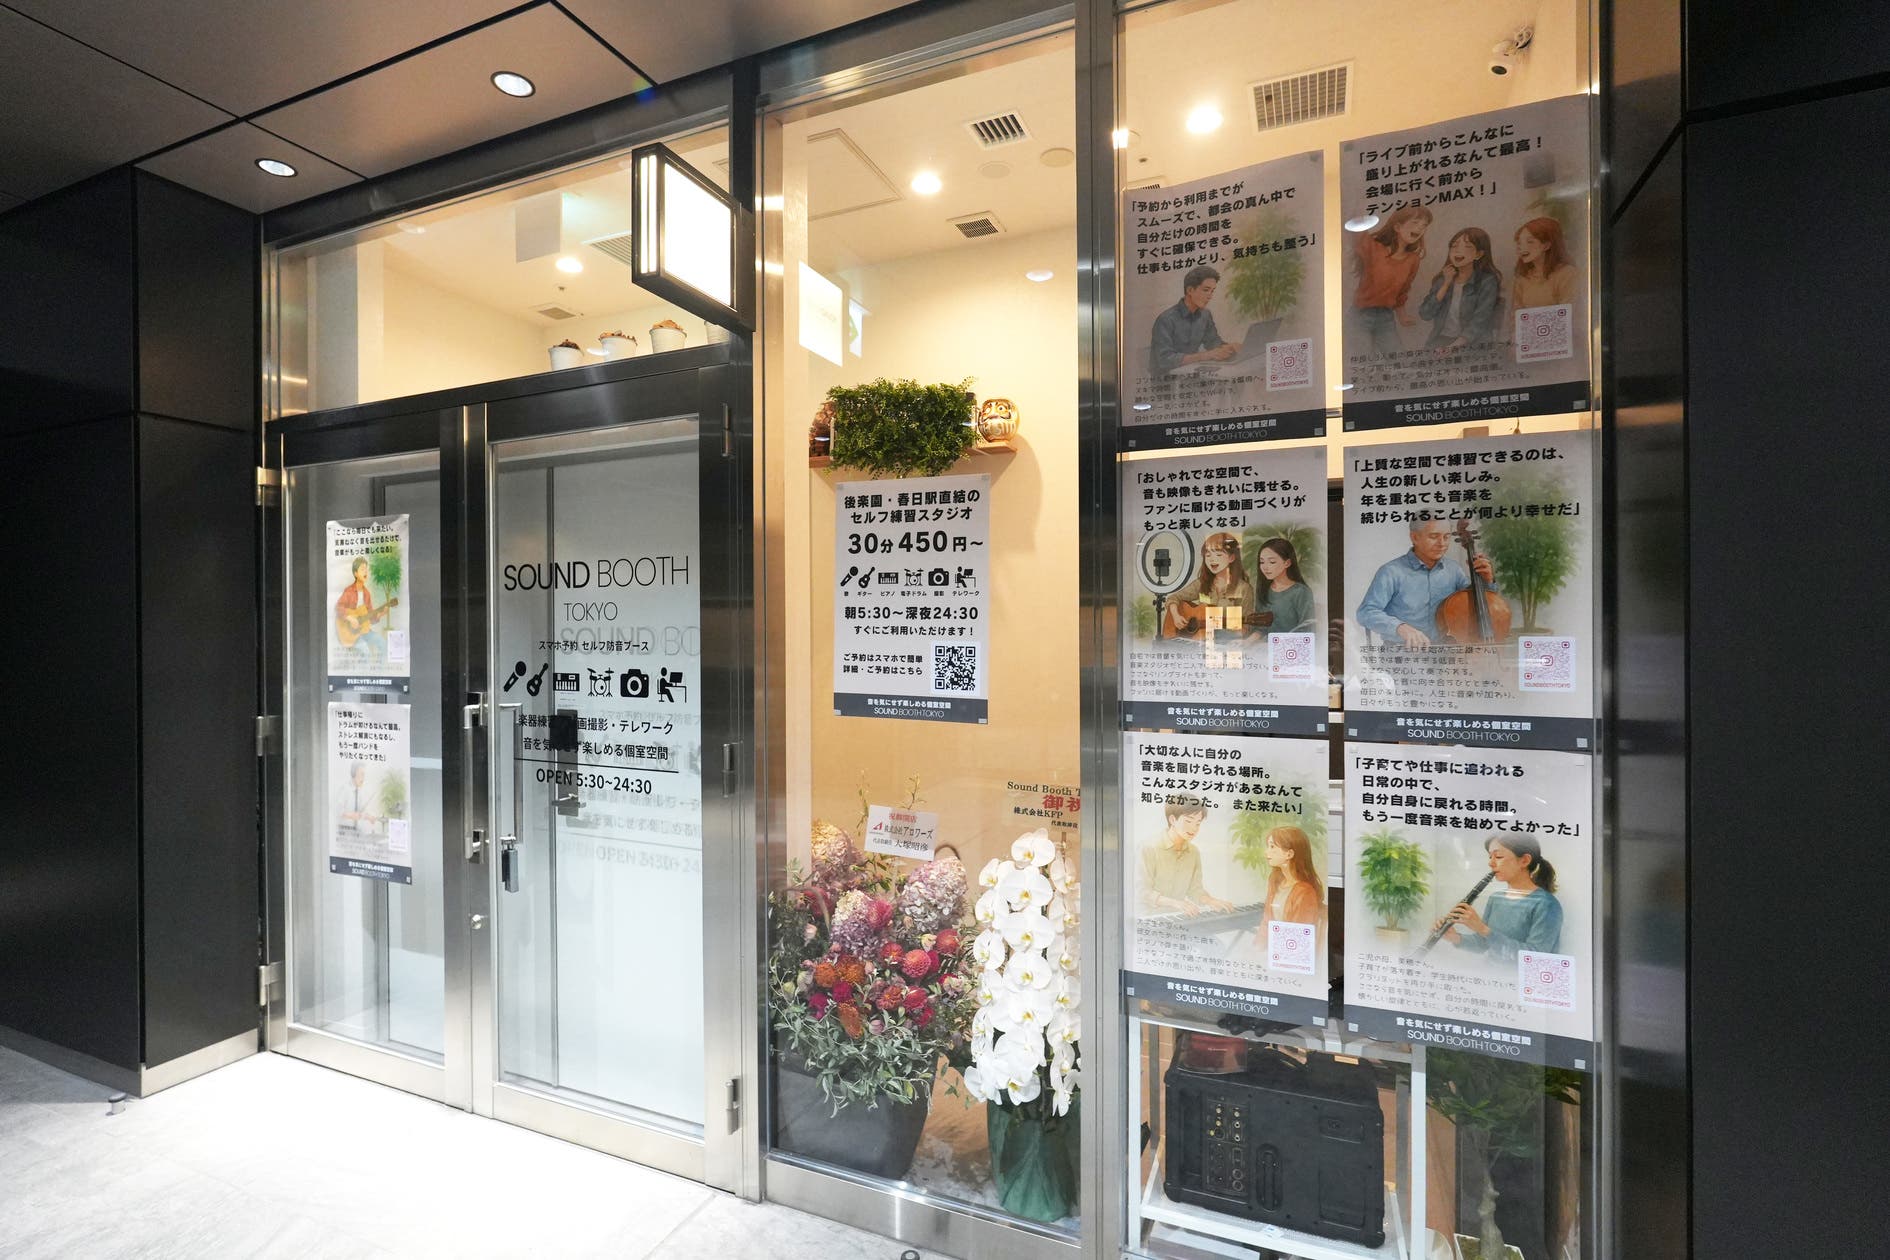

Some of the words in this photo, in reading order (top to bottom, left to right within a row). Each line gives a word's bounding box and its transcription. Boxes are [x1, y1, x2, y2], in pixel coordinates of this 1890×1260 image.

[1359, 124, 1514, 165] 「ライブ前からこんなに
[1366, 136, 1542, 182] 盛り上がれるなんて最高！
[1366, 167, 1482, 199] 会場に行く前から
[1131, 181, 1244, 213] 「予約から利用までが
[1366, 181, 1496, 216] テンションMAX！」
[1137, 188, 1296, 228] スムーズで、都会の真ん中で
[1137, 219, 1232, 244] 自分だけの時間を
[1137, 237, 1239, 259] すぐに確保できる。
[1137, 233, 1316, 274] 仕事もはかどり、気持ちも整う」
[1395, 393, 1530, 413] 音を気にせず楽しめる個室空間
[1406, 411, 1444, 423] SOUND
[1174, 435, 1206, 445] SOUND
[1354, 447, 1565, 473] 「上質な空間で練習できるのは、
[1137, 465, 1260, 485] 「おしゃれでな空間で、
[1361, 470, 1501, 489] 人生の新しい楽しみ。
[844, 489, 980, 509] 後楽園・春日駅直結の
[1143, 480, 1300, 500] 音も映像もきれいに残せる。
[1361, 488, 1492, 507] 年を重ねても音楽を
[851, 506, 973, 524] セルフ練習スタジオ
[1144, 494, 1306, 516] ファンに届ける動画づくりが
[1361, 502, 1580, 525] 続けられることが何より幸せだ」
[1144, 515, 1247, 532] もっと楽しくなる」
[504, 561, 590, 591] SOUND
[597, 555, 690, 588] BOOTH
[564, 601, 618, 621] TOKYO
[854, 625, 974, 637] すぐにご利用いただけます！
[538, 640, 578, 651] スマホ予約
[581, 640, 649, 652] セルフ防音ブース
[843, 653, 923, 663] ご予約はスマホで簡単
[843, 665, 923, 675] 詳細・ご予約はこちら
[874, 707, 898, 716] SOUND
[1167, 707, 1279, 718] 音を気にせず楽しめる個室空間
[518, 714, 673, 736] 楽器練画撮影・テレワーク
[1176, 717, 1208, 727] SOUND
[1396, 717, 1531, 731] 音を気にせず楽しめる個室空間
[1407, 728, 1445, 739] SOUND
[1138, 744, 1242, 761] 「大切な人に自分の
[1141, 760, 1271, 779] 音楽を届けられる場所。
[1355, 757, 1524, 778] 「子育てや仕事に追われる
[536, 768, 573, 786] OPEN
[576, 773, 652, 795] 5:30~24:30
[1007, 781, 1039, 793] Sound
[1041, 785, 1072, 796] Booth
[1141, 776, 1302, 798] こんなスタジオがあるなんて
[1362, 775, 1440, 791] 日常の中で、
[1140, 791, 1220, 809] 知らなかった。
[1232, 798, 1302, 815] また来たい」
[1362, 792, 1517, 814] 自分自身に戻れる時間。
[1362, 809, 1580, 836] もう一度音楽を始めてよかった」
[1166, 981, 1279, 1006] 音を気にせず楽しめる個室空間
[1175, 993, 1208, 1005] SOUND
[1396, 1016, 1531, 1046] 音を気にせず楽しめる個室空間
[1407, 1029, 1445, 1044] SOUND
